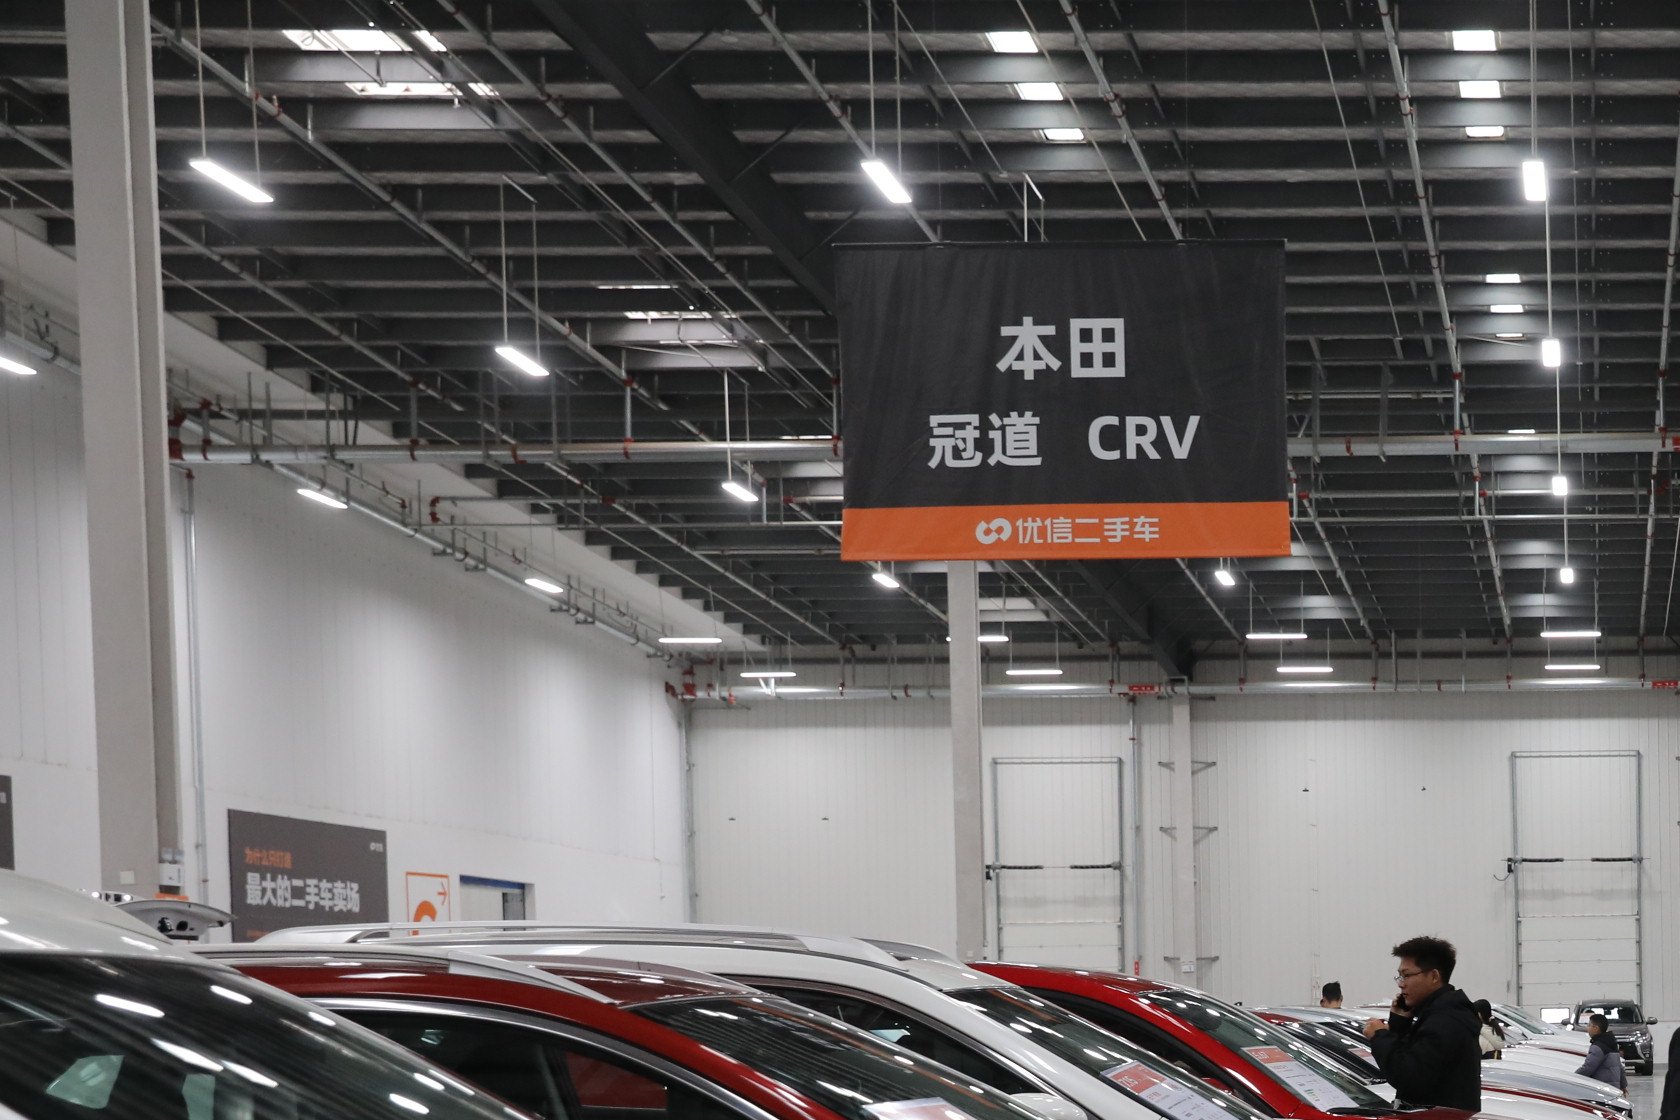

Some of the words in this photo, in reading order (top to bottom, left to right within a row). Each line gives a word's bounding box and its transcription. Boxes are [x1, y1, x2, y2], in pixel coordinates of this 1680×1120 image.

[996, 316, 1126, 381] 本田
[928, 411, 1043, 470] 冠道
[1088, 415, 1201, 461] CRV
[1016, 515, 1160, 544] 优信二手车
[245, 871, 361, 913] 最大的二手车卖场
